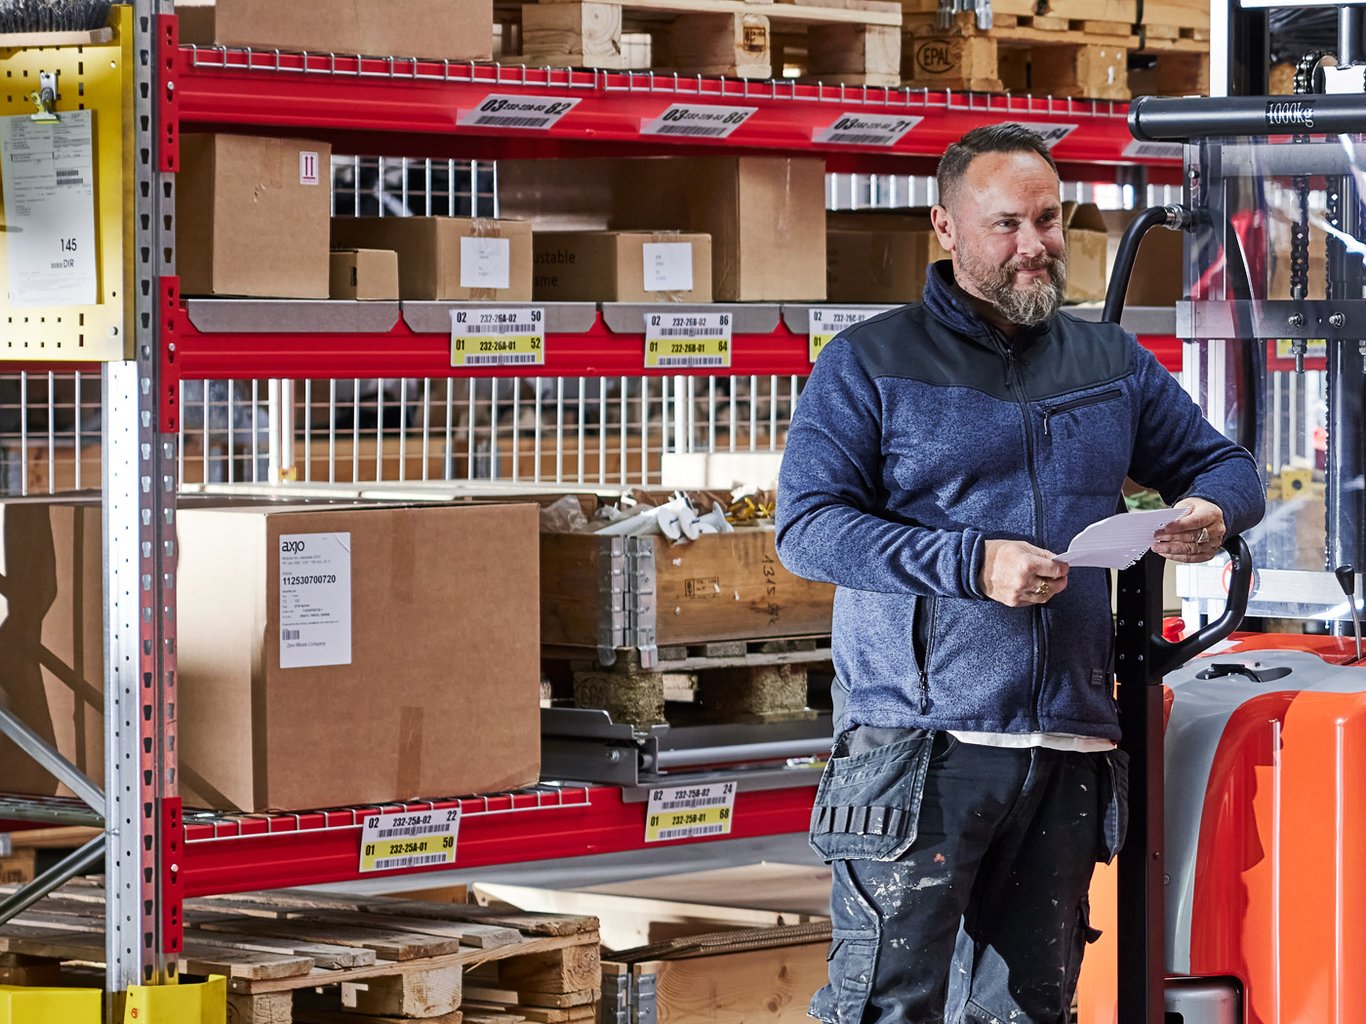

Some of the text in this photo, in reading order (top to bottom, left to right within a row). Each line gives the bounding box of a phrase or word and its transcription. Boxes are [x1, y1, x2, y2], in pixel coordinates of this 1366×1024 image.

[923, 49, 950, 66] EPAL
[480, 99, 508, 112] 03
[544, 102, 572, 115] 82
[662, 109, 689, 122] 03
[722, 111, 749, 124] 86
[1267, 101, 1315, 128] 1000kg
[833, 118, 859, 130] 03
[888, 120, 912, 133] 21
[60, 238, 77, 252] 145
[63, 258, 75, 269] DIR
[457, 311, 541, 323] 02 232-26A-02 50
[651, 316, 661, 326] 02
[720, 315, 729, 325] 86
[814, 311, 822, 321] 02
[456, 338, 541, 350] 01 232-26A-01 52
[649, 341, 658, 352] 01
[718, 341, 728, 351] 64
[814, 336, 822, 347] 01
[282, 541, 305, 555] axjo
[283, 575, 336, 586] 112530700720
[654, 790, 664, 801] 02
[723, 784, 733, 794] 24
[368, 810, 457, 828] 02 232-25A-02 22
[650, 816, 659, 827] 01
[719, 808, 730, 819] 68
[365, 836, 454, 856] 01 232-25A-01 50
